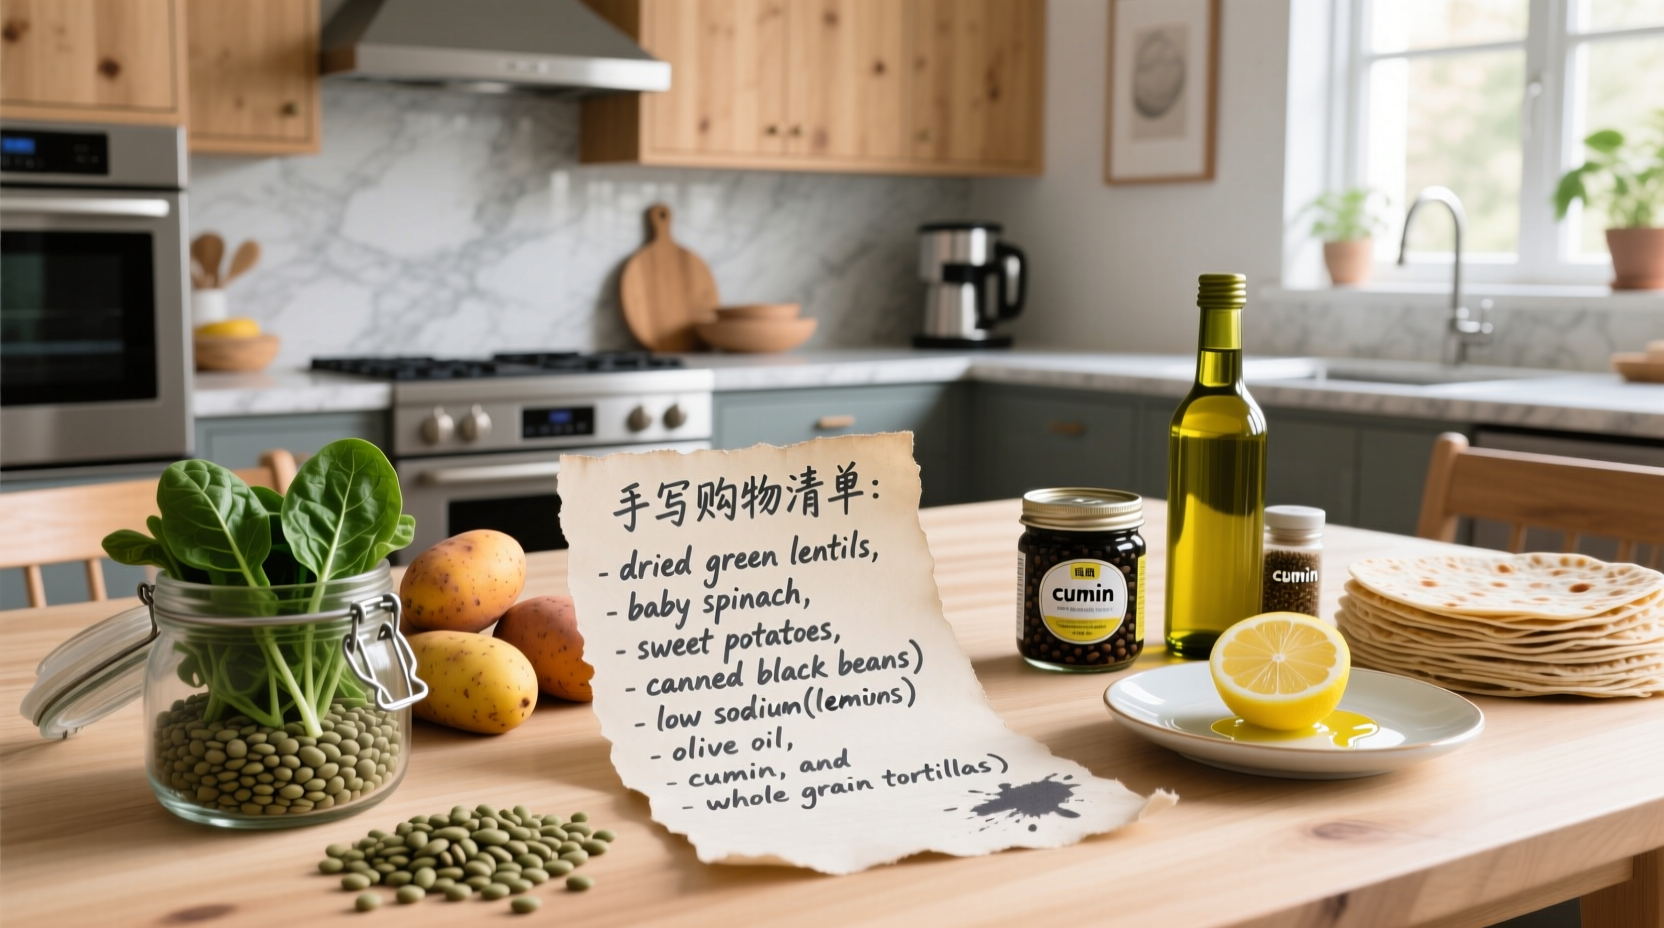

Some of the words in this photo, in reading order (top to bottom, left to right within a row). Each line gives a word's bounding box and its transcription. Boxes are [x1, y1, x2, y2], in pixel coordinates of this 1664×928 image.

[612, 461, 880, 533] 手写购物清单:
[619, 544, 693, 581] dried
[703, 550, 779, 589] green
[790, 529, 879, 565] lentils,
[1272, 566, 1319, 583] cumin
[627, 588, 691, 630] baby
[702, 577, 811, 625] spinach,
[1052, 583, 1114, 603] cumin
[637, 628, 715, 660] sweet
[723, 621, 842, 665] potatoes,
[645, 660, 744, 697] canned
[757, 654, 829, 687] black
[838, 639, 924, 676] beans)
[656, 704, 702, 732] low
[672, 735, 740, 762] olive
[751, 726, 794, 752] oil,
[688, 764, 787, 788] cumin,
[799, 748, 851, 774] and
[706, 785, 791, 812] whole
[801, 777, 874, 811] grain
[881, 753, 1010, 789] tortillas)
